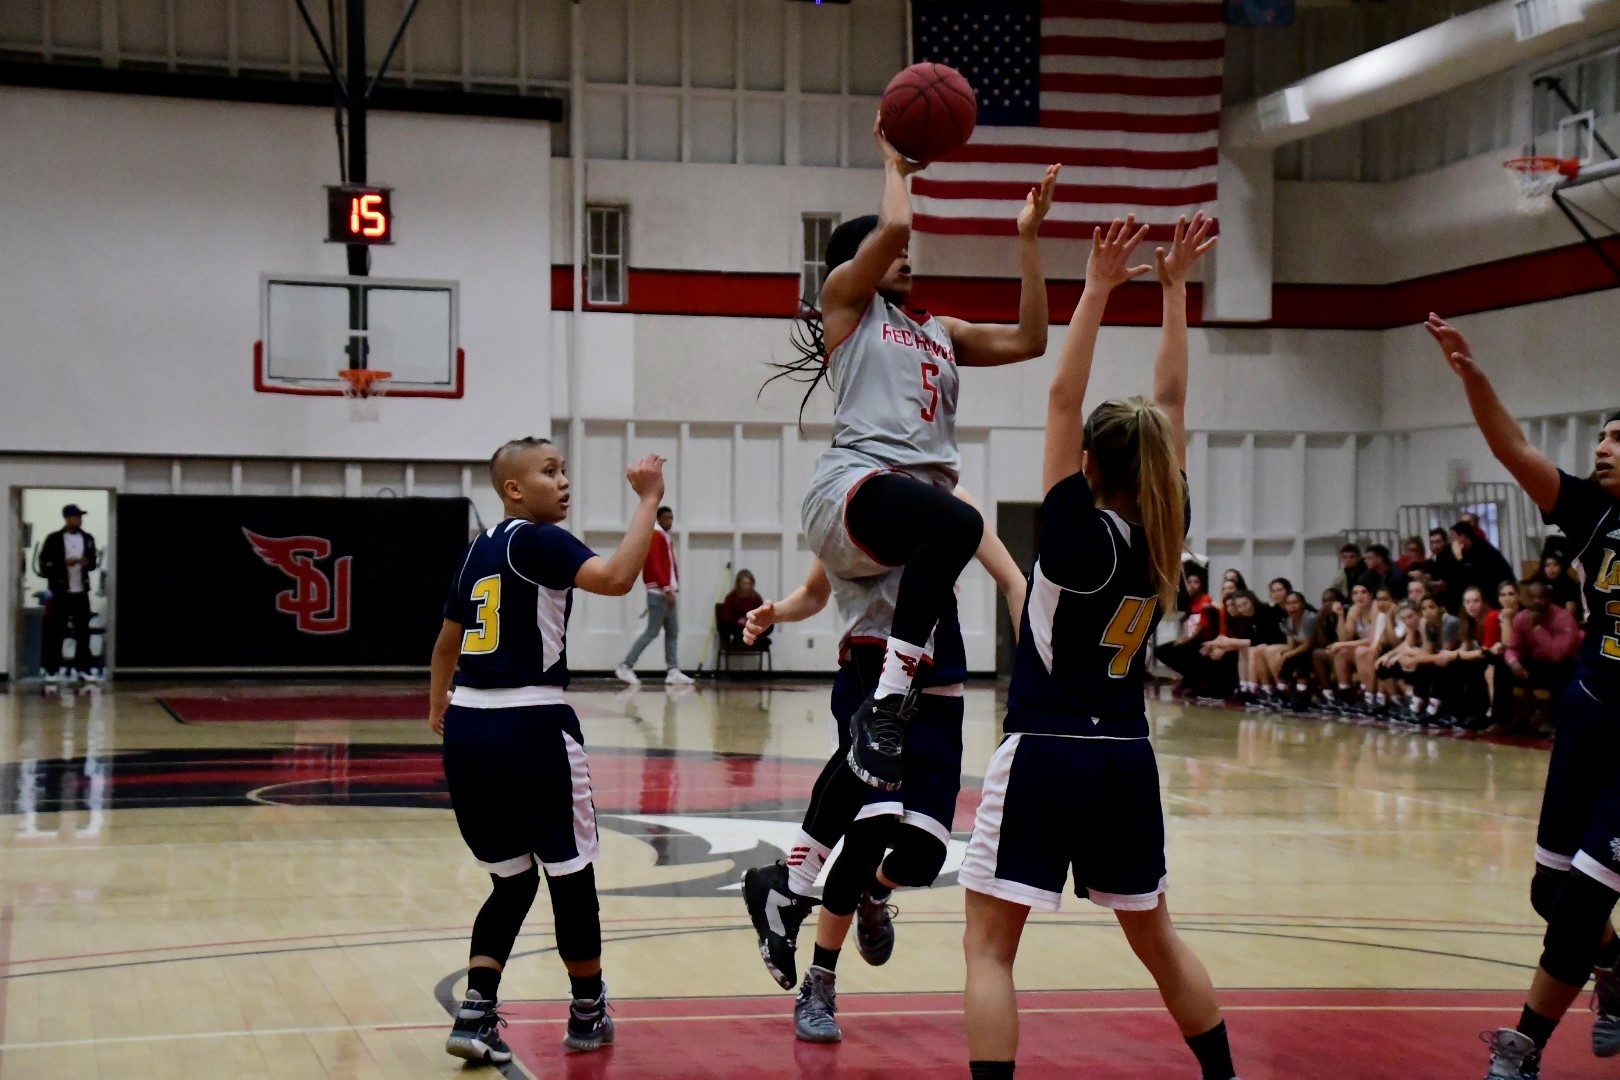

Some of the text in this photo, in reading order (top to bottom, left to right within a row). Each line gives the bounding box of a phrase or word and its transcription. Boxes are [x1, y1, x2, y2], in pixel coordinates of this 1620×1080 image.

[351, 194, 386, 237] 15
[920, 361, 940, 423] 5
[461, 573, 501, 655] 3
[1099, 594, 1159, 678] 4
